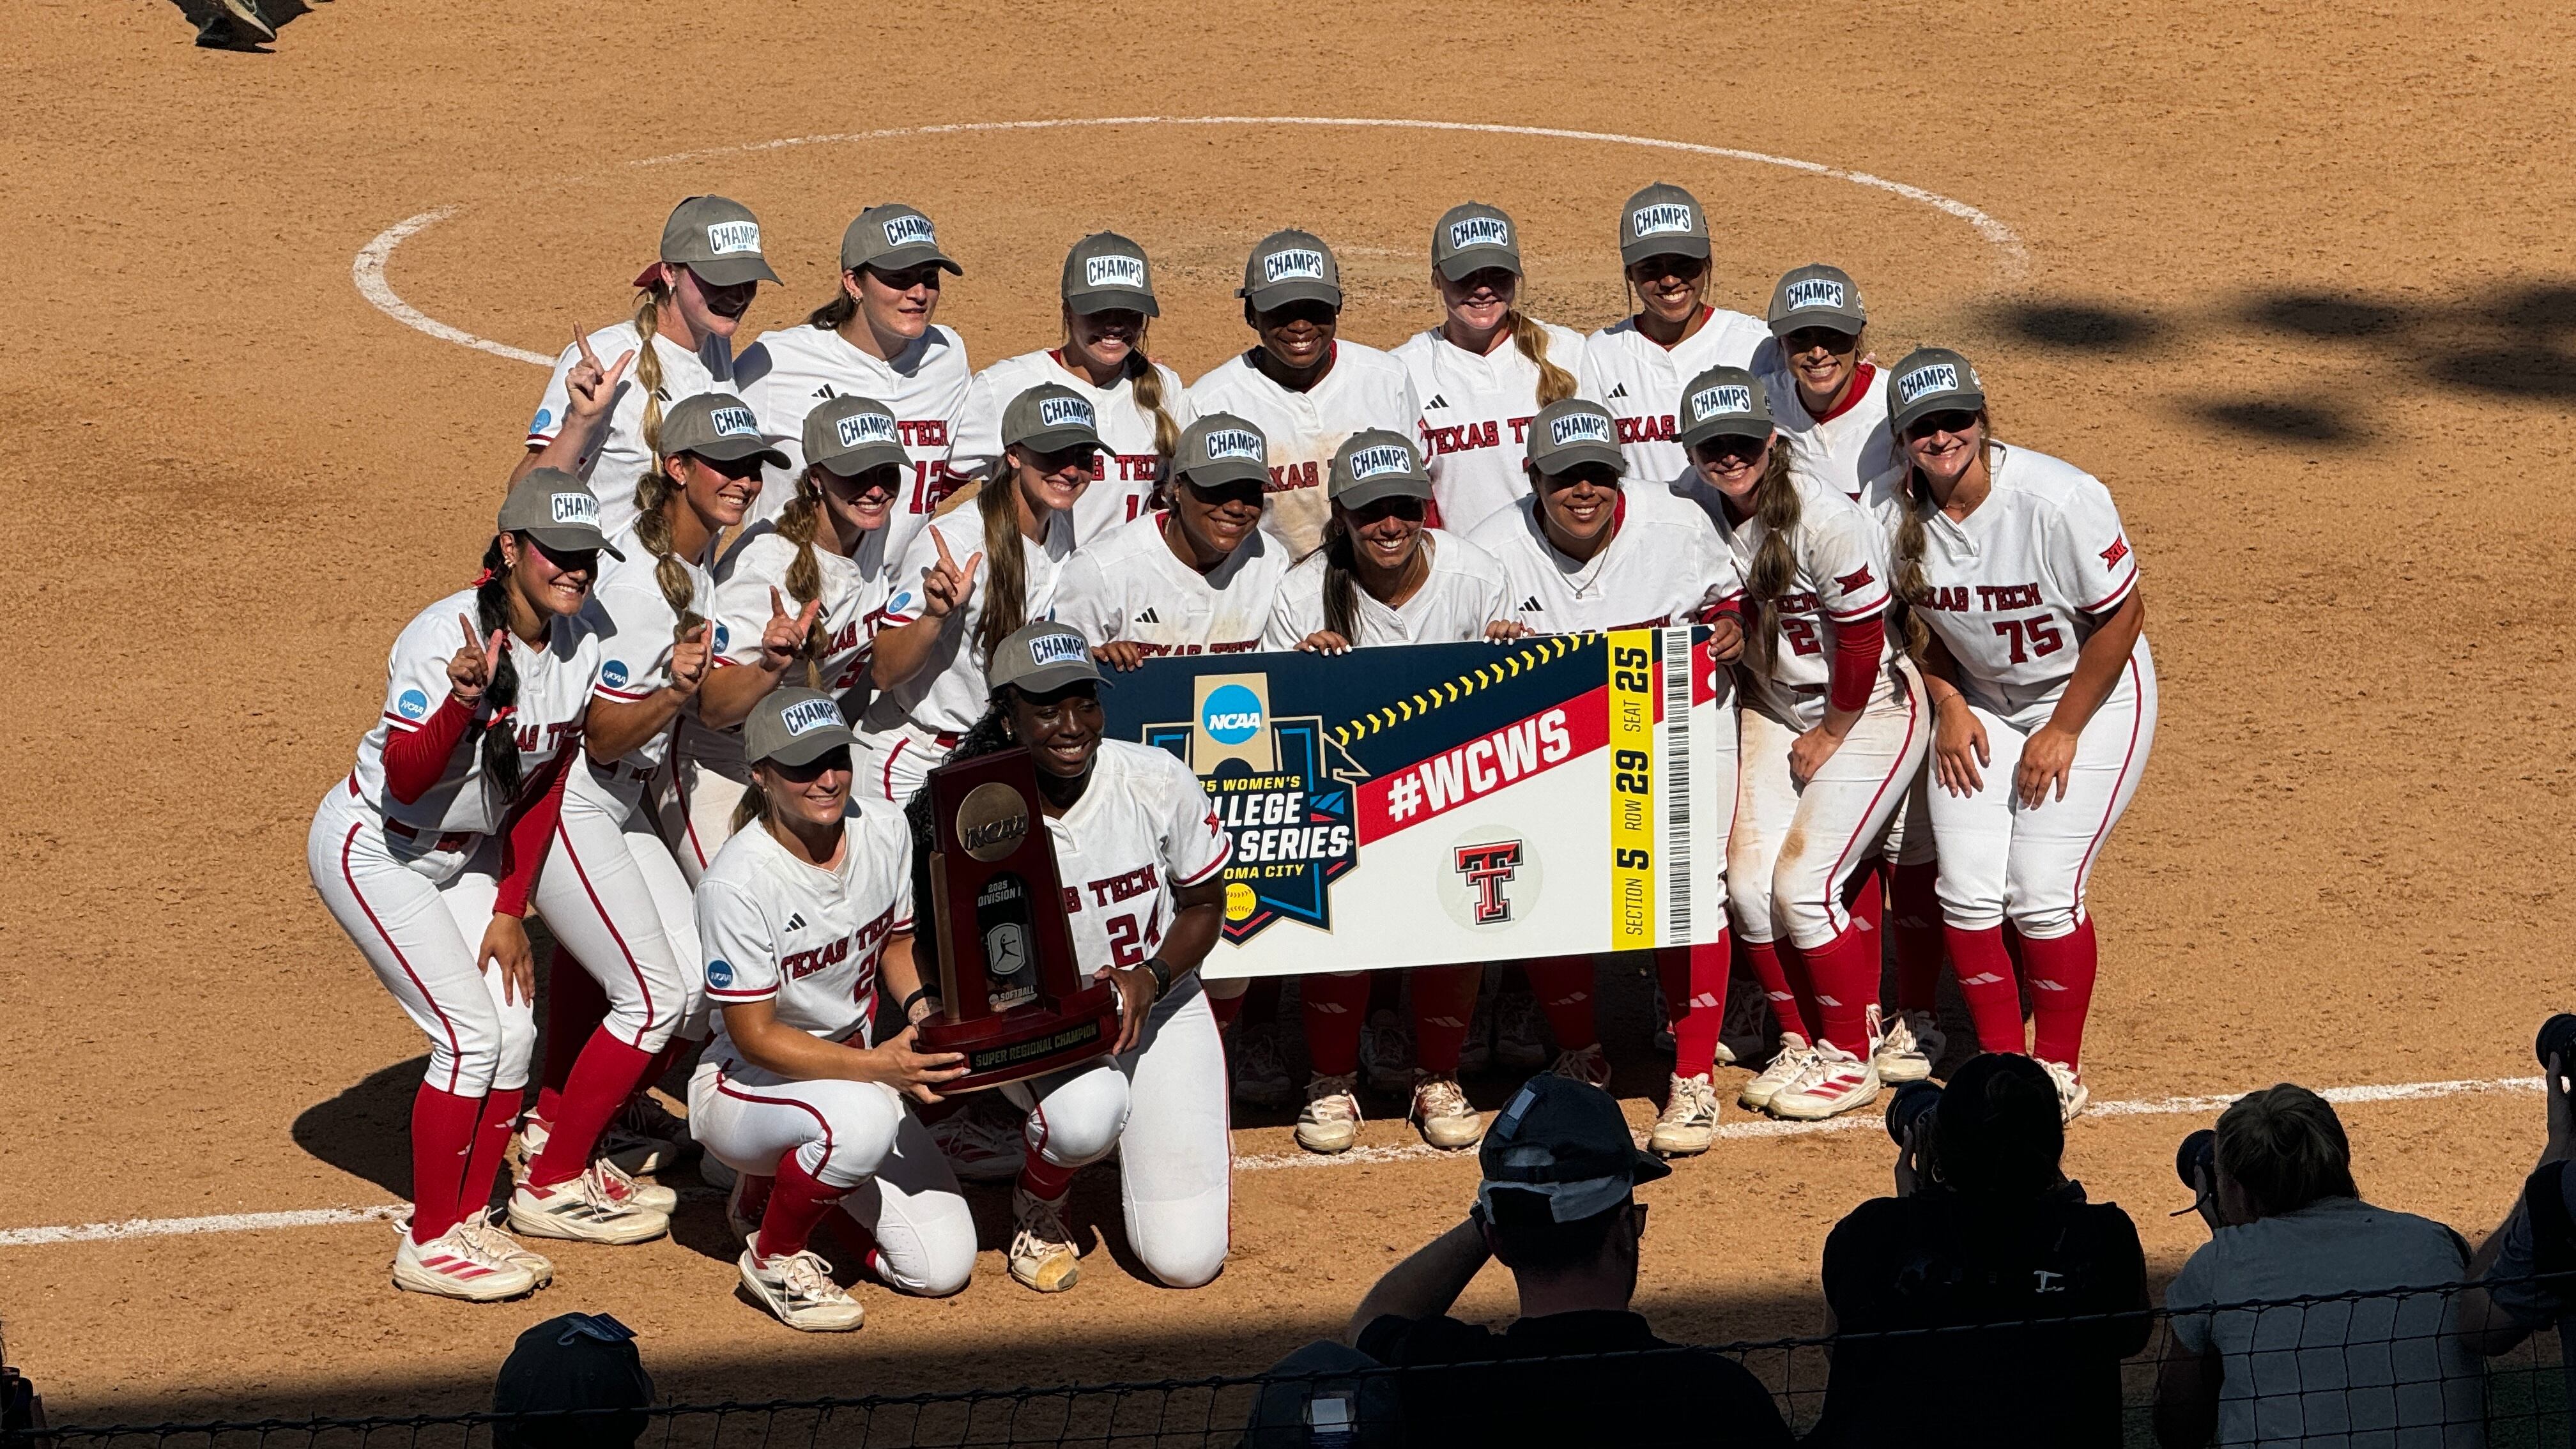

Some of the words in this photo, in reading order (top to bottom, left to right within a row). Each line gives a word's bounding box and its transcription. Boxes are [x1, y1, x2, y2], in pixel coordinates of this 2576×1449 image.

[1453, 220, 1506, 248] CHAMPS
[1636, 206, 1692, 236] CHAMPS
[1089, 259, 1142, 286] CHAMPS
[1267, 253, 1322, 280] CHAMPS
[1788, 283, 1841, 309] CHAMPS
[1901, 368, 1956, 402] CHAMPS
[1043, 401, 1094, 429] CHAMPS
[1694, 388, 1749, 420] CHAMPS
[839, 417, 895, 445] CHAMPS
[897, 420, 950, 447] TECH
[1423, 420, 1499, 454] TEXAS
[1553, 417, 1608, 444] CHAMPS
[1614, 415, 1676, 444] EXAS
[1209, 433, 1261, 461] CHAMPS
[1115, 455, 1160, 480] TEC
[1268, 461, 1319, 492] XAS
[1353, 449, 1409, 478] CHAMPS
[1777, 592, 1820, 613] ECH
[1922, 586, 1969, 612] XAS
[1975, 582, 2044, 611] TECH
[1993, 613, 2064, 664] 75
[604, 670, 626, 684] NCAA
[1615, 647, 1648, 693] 25
[401, 700, 424, 715] NCAA
[785, 702, 843, 734] CHAMPS
[1209, 712, 1261, 730] NCAA
[1623, 699, 1641, 733] SEAT
[1388, 709, 1571, 822] #WCWS
[1615, 749, 1648, 795] 29
[1223, 776, 1301, 792] WOMEN'S
[1213, 792, 1303, 827] LLEGE
[1624, 799, 1642, 831] ROW
[964, 813, 1028, 851] NCAA
[1238, 825, 1350, 862] SERIES
[1265, 864, 1305, 878] CITY
[1616, 848, 1649, 870] 5
[977, 887, 1016, 907] DIVISION
[1018, 885, 1022, 896] I
[988, 880, 1008, 893] 2025
[1087, 863, 1159, 908] TECH
[1625, 878, 1643, 935] SECTION
[780, 937, 850, 986] TEXAS
[1000, 985, 1035, 1002] SOFTBALL
[976, 1050, 1008, 1067] SUPER
[1009, 1038, 1053, 1061] REGIONAL
[1054, 1023, 1097, 1048] CHAMPION
